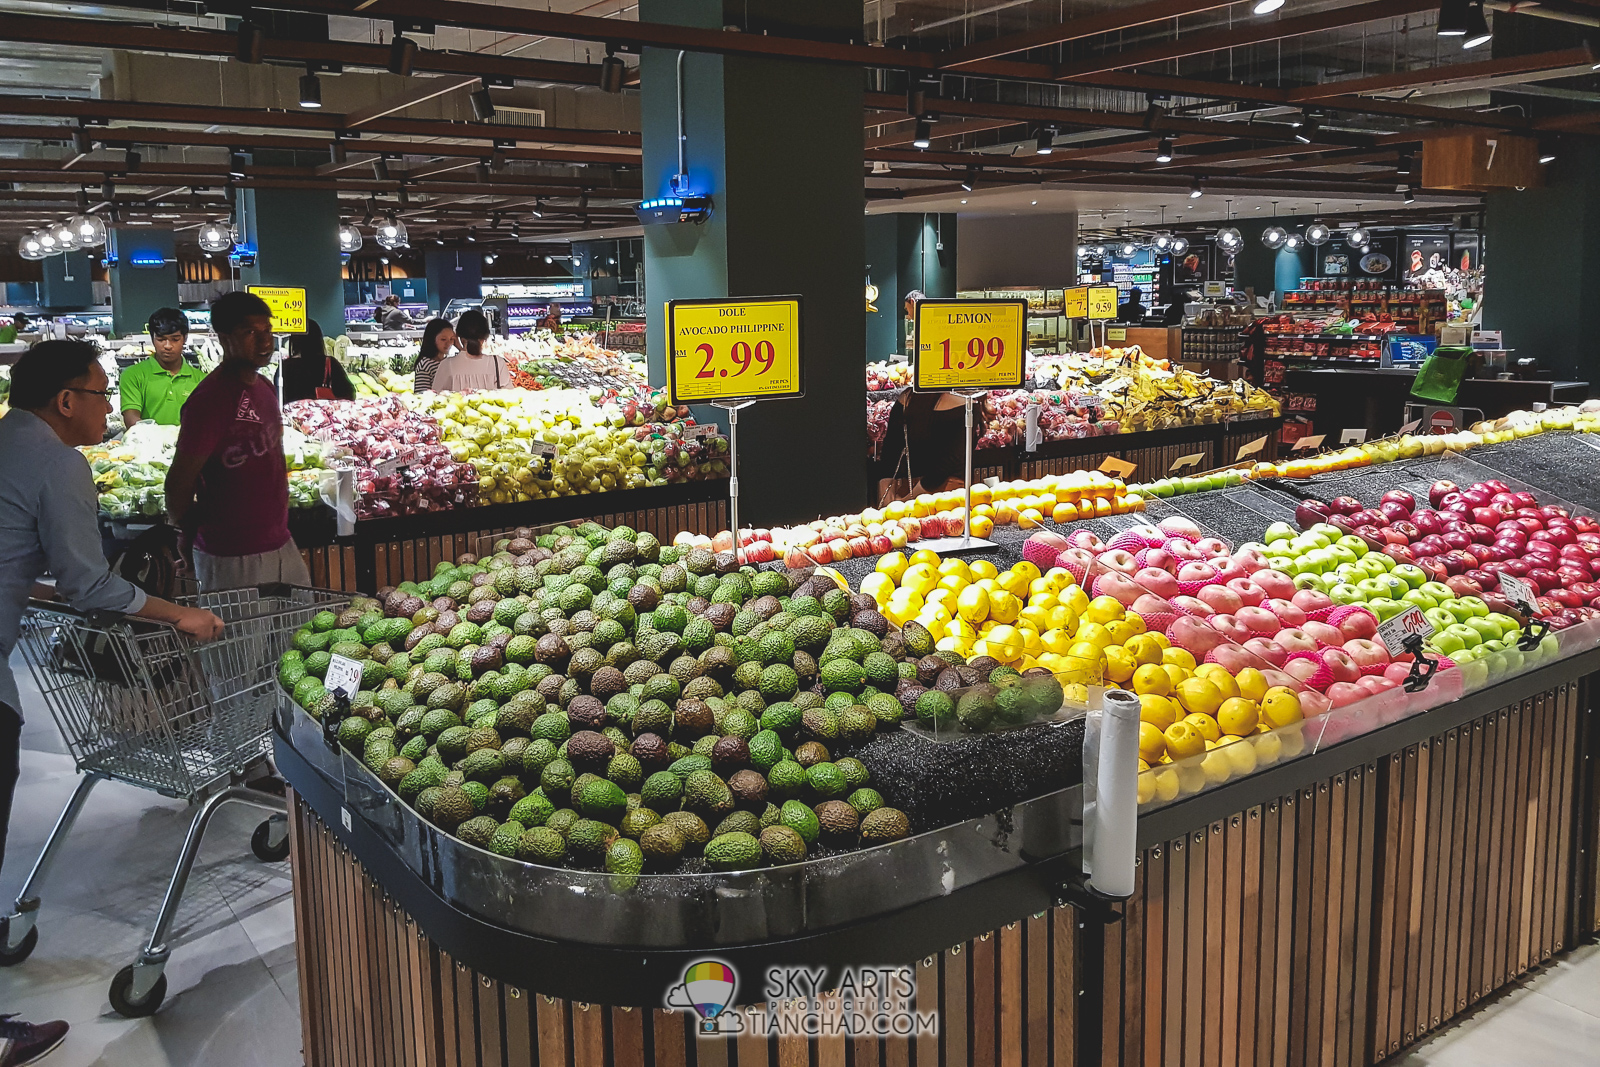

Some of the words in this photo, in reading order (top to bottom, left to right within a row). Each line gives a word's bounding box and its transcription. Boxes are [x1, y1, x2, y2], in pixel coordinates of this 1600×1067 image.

[1486, 139, 1498, 171] 7
[284, 300, 303, 310] 6.99
[1095, 301, 1112, 313] 9.59
[718, 307, 747, 318] DOLE
[947, 313, 992, 324] LEMON
[279, 317, 303, 327] 14.99
[679, 325, 728, 336] AVOCADO
[730, 323, 785, 334] PHILIPPINE
[675, 349, 687, 357] RM
[694, 340, 775, 379] 2.99
[920, 343, 932, 351] RM
[939, 337, 1005, 370] 1.99
